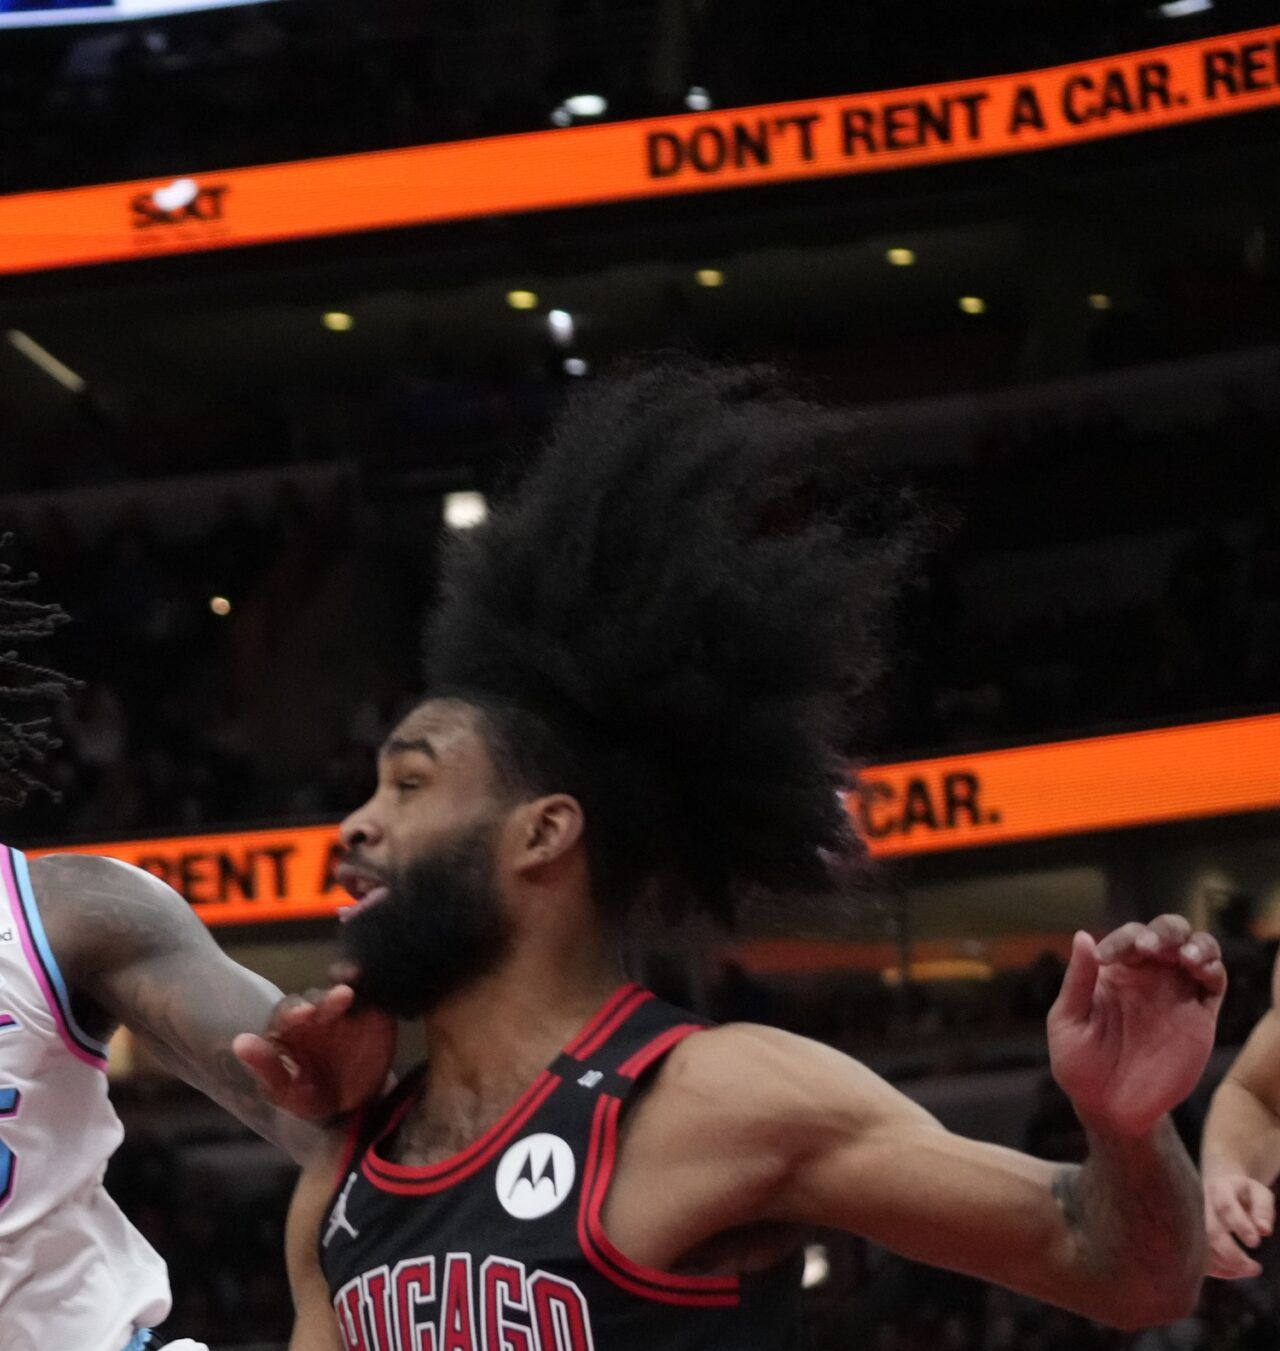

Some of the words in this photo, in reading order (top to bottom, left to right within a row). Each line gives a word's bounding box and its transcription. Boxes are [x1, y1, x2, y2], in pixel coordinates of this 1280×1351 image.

[647, 113, 821, 179] DON'T
[842, 93, 989, 157] RENT
[1007, 85, 1045, 137] A
[1064, 61, 1188, 126] CAR.
[1204, 40, 1280, 99] RE
[860, 771, 1002, 838] CAR.
